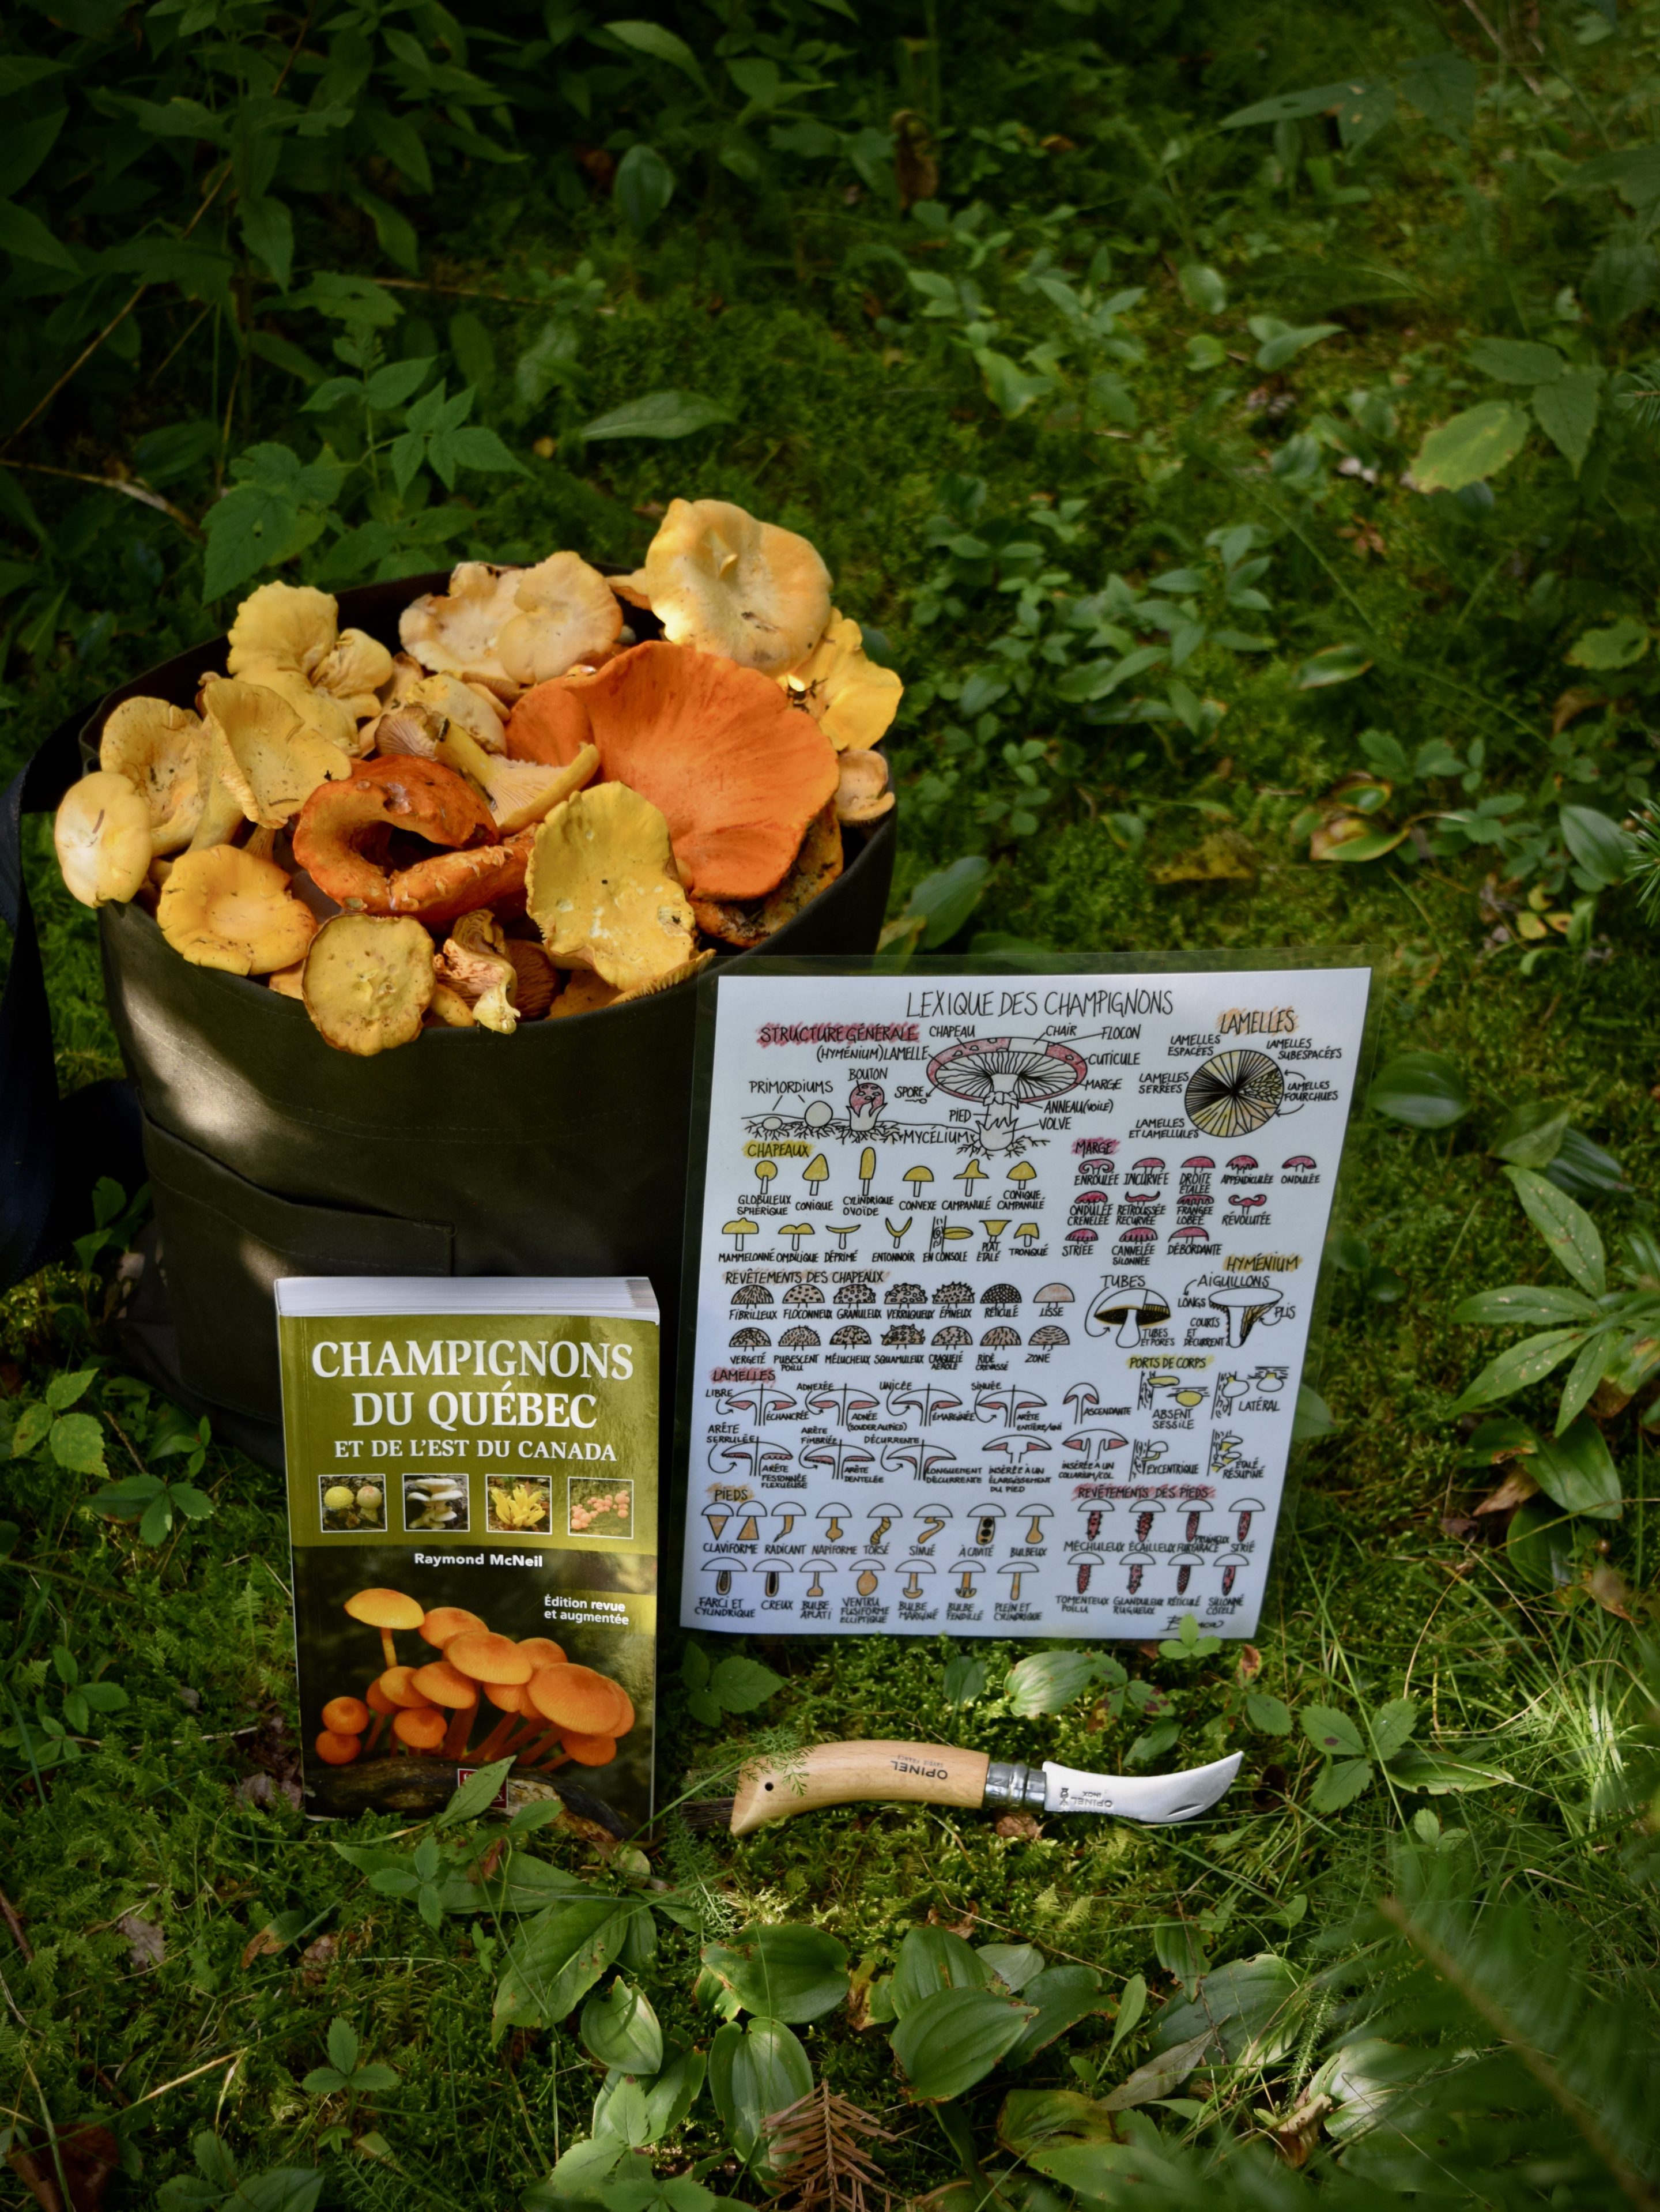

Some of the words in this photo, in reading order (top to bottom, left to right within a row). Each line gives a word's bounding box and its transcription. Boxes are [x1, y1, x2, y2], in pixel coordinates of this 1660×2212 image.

[907, 991, 994, 1018] LEXIQUE
[998, 992, 1038, 1017] DES
[1044, 988, 1173, 1018] CHAMPIGNONS
[1220, 1009, 1295, 1034] LAMELLES
[760, 1026, 842, 1042] STRUCTURE
[846, 1023, 918, 1043] GÉNÉRALE
[929, 1026, 975, 1038] CHAPEAU
[1101, 1024, 1141, 1039] FLOCON
[1171, 1034, 1220, 1045] LAMELLES
[1267, 1039, 1311, 1049] LAMELLES
[1168, 1046, 1213, 1056] ESPACÉES
[1278, 1047, 1342, 1060] SUBESPACÉES
[848, 1068, 888, 1081] BOUTON
[1139, 1072, 1189, 1083] LAMELLES
[1086, 1079, 1122, 1091] MARGE
[1139, 1083, 1182, 1094] SERRÉES
[1288, 1081, 1330, 1091] LAMELLES
[895, 1086, 923, 1098] SPORE
[1285, 1091, 1338, 1101] FOURCHUES
[1039, 1117, 1071, 1130] VOLVE
[1136, 1118, 1184, 1128] LAMELLES
[1129, 1130, 1142, 1139] ET
[1142, 1129, 1199, 1139] LAMELLULES
[748, 1144, 809, 1158] CHAPEAUX
[1075, 1140, 1113, 1158] MARGE
[1074, 1171, 1119, 1185] ENROULÉE
[1123, 1170, 1169, 1185] INCURVÉE
[1281, 1174, 1320, 1184] ONDULÉE
[738, 1194, 791, 1205] GLOBULEUX
[942, 1196, 991, 1211] CAMPANULÉ
[997, 1197, 1046, 1211] CAMPANULÉ
[899, 1201, 937, 1211] CONVEXE
[1070, 1203, 1113, 1216] ONDULÉE
[1116, 1203, 1166, 1216] RETROUSSÉE
[1222, 1211, 1272, 1226] RÉVOLUTÉE
[982, 1242, 1001, 1252] PLAT
[1009, 1244, 1048, 1256] TRONQUÉ
[1111, 1242, 1155, 1256] CANNELÉE
[1167, 1242, 1223, 1255] DÉBORDANTE
[719, 1248, 775, 1263] MAMMELONNÉ
[923, 1253, 933, 1263] EN
[935, 1252, 967, 1262] CONSOLE
[726, 1268, 802, 1284] REVÊTEMENTS
[807, 1271, 828, 1283] DES
[832, 1271, 884, 1283] CHAPEAUX
[1101, 1275, 1145, 1288] TUBES
[1178, 1298, 1206, 1307] LONGS
[783, 1309, 833, 1319] FLOCONNEUX
[837, 1309, 882, 1319] GRANULEUX
[887, 1310, 935, 1319] VERRUQUEUX
[1190, 1317, 1220, 1327] COURTS
[1142, 1328, 1168, 1337] TUBES
[1187, 1328, 1197, 1337] ET
[1140, 1338, 1150, 1347] ET
[1151, 1337, 1175, 1347] PORES
[312, 1340, 633, 1381] CHAMPIGNONS
[730, 1352, 766, 1364] VERGETÉ
[774, 1354, 819, 1365] PUBESCENT
[825, 1353, 871, 1364] MÉLUCHEUX
[874, 1355, 923, 1365] SQUAMULEUX
[929, 1350, 963, 1363] CRAQUELÉ
[1025, 1350, 1051, 1363] ZONÉ
[1129, 1357, 1160, 1369] PORTS
[1163, 1358, 1174, 1368] DE
[1176, 1357, 1206, 1369] CORPS
[713, 1370, 776, 1382] LAMELLES
[796, 1381, 834, 1391] ADNEXÉE
[705, 1389, 733, 1397] LIBRE
[352, 1392, 414, 1426] DU
[428, 1380, 597, 1432] QUÉBEC
[1238, 1396, 1280, 1411] LATÉRAL
[766, 1410, 809, 1420] ÉCHANCRÉE
[851, 1411, 877, 1421] ADNÉE
[1083, 1407, 1131, 1416] ASCENDANTE
[1152, 1408, 1193, 1419] ABSENT
[707, 1434, 755, 1443] SERRULÉE
[864, 1434, 919, 1444] DÉCURRENTE
[335, 1441, 363, 1458] ET
[372, 1441, 402, 1457] DE
[410, 1440, 469, 1457] L'EST
[477, 1440, 510, 1457] DU
[518, 1441, 617, 1461] CANADA
[761, 1474, 807, 1482] FESTONNÉE
[844, 1475, 884, 1483] DENTELÉE
[926, 1475, 982, 1484] DÉCURRENTE
[1078, 1486, 1148, 1498] REVÊTEMENTS
[1153, 1488, 1175, 1498] DES
[1180, 1486, 1208, 1498] PIEDS
[863, 1542, 890, 1555] TORSÉ
[1063, 1540, 1125, 1552] MÉCHULEUX
[1010, 1547, 1047, 1557] BULBEUX
[414, 1553, 484, 1567] Raymond
[490, 1554, 543, 1567] McNeil
[544, 1595, 587, 1610] Édition
[590, 1601, 626, 1612] revue
[731, 1599, 744, 1608] ET
[761, 1600, 793, 1610] CREUX
[802, 1600, 829, 1610] BULBE
[842, 1597, 879, 1607] VENTRU
[898, 1601, 928, 1611] BULBE
[1055, 1596, 1109, 1606] TOMENTEUX
[1113, 1596, 1164, 1606] GLANDULEUX
[948, 1603, 975, 1612] BULBE
[1019, 1603, 1032, 1612] ET
[1113, 1606, 1155, 1614] RUGUEUX
[544, 1608, 557, 1619] et
[560, 1609, 629, 1625] augmentée
[890, 1761, 948, 1780] OPINEL
[1071, 1797, 1113, 1807] OPINEL
